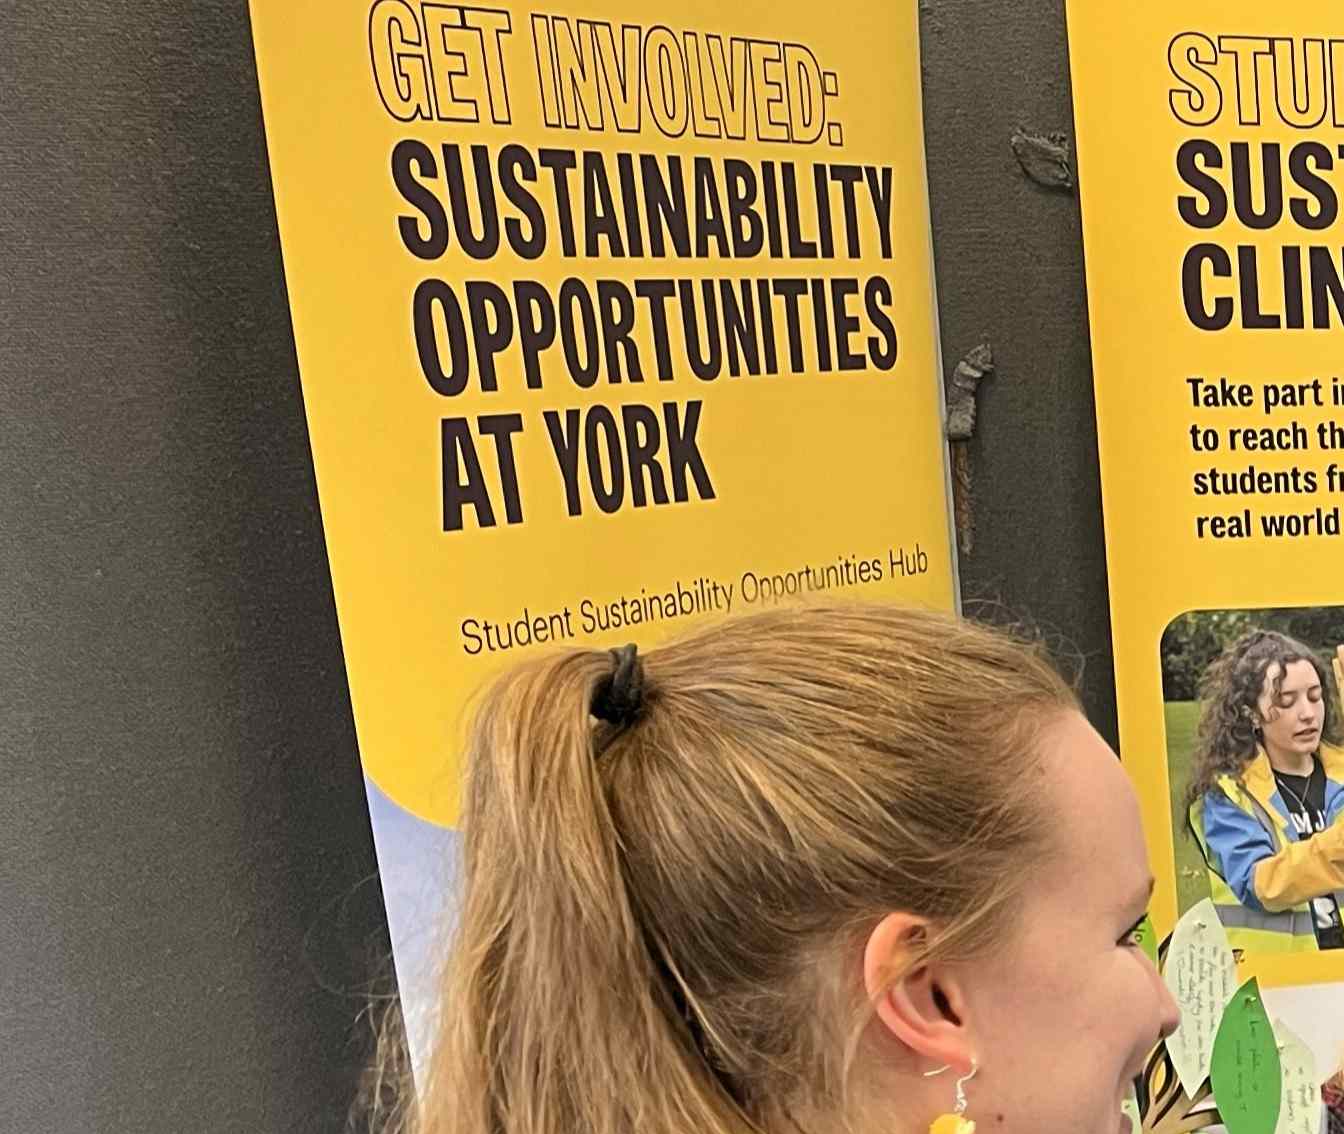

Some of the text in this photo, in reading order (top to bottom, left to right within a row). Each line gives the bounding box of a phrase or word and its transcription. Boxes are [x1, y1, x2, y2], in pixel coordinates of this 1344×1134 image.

[368, 0, 844, 147] GET INVOLVED:
[391, 135, 893, 261] SUSTAINABILITY
[412, 275, 898, 397] OPPORTUNITIES
[1186, 377, 1254, 408] Take
[1263, 379, 1324, 415] part
[1189, 424, 1219, 452] to
[1229, 421, 1308, 451] reach
[441, 399, 716, 532] AT YORK
[1193, 465, 1318, 496] students
[1196, 509, 1251, 539] real
[1260, 507, 1340, 537] world
[460, 543, 928, 656] Student Sustainability Opportunities Hub
